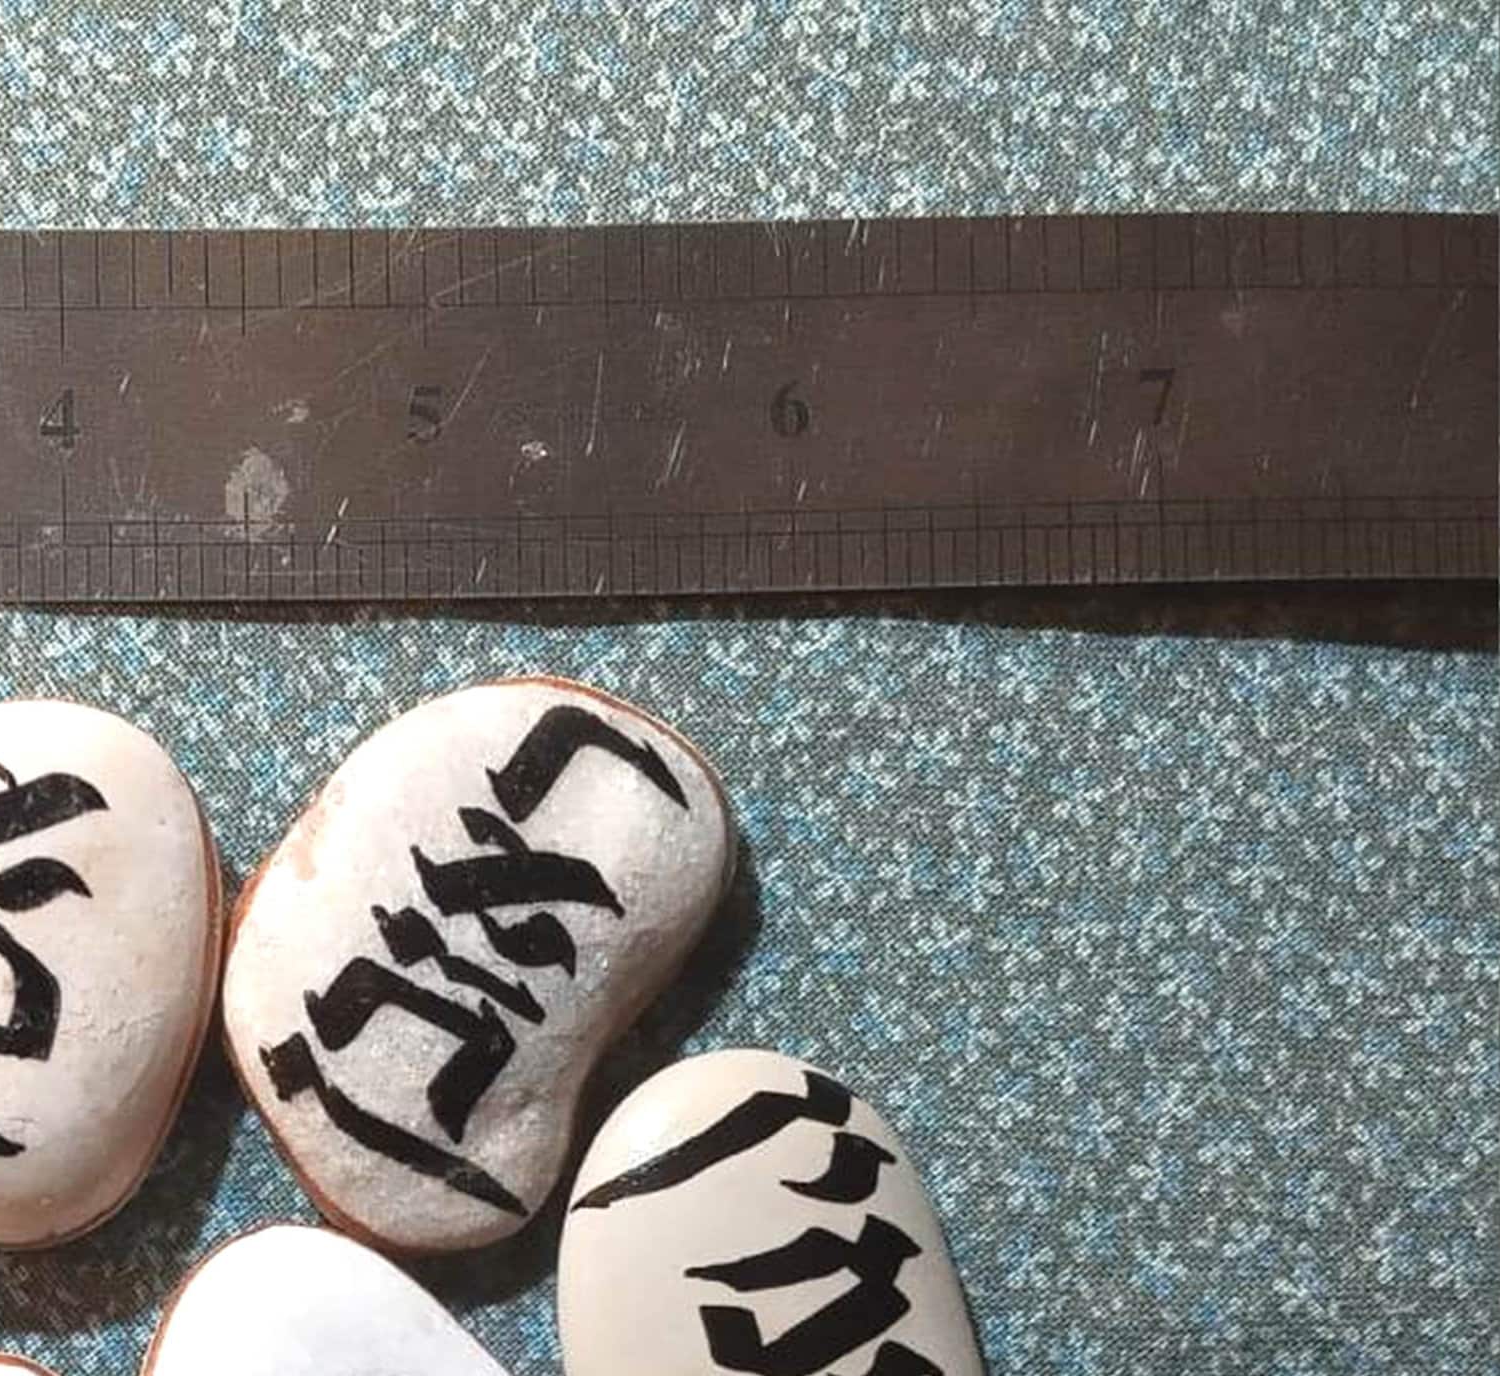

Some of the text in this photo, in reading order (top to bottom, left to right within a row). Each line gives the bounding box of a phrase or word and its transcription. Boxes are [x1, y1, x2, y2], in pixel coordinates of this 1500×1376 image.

[40, 389, 79, 453] 4
[407, 386, 442, 442] 5
[770, 382, 808, 437] 6
[1139, 368, 1176, 424] 7
[259, 705, 689, 1217] ראובן
